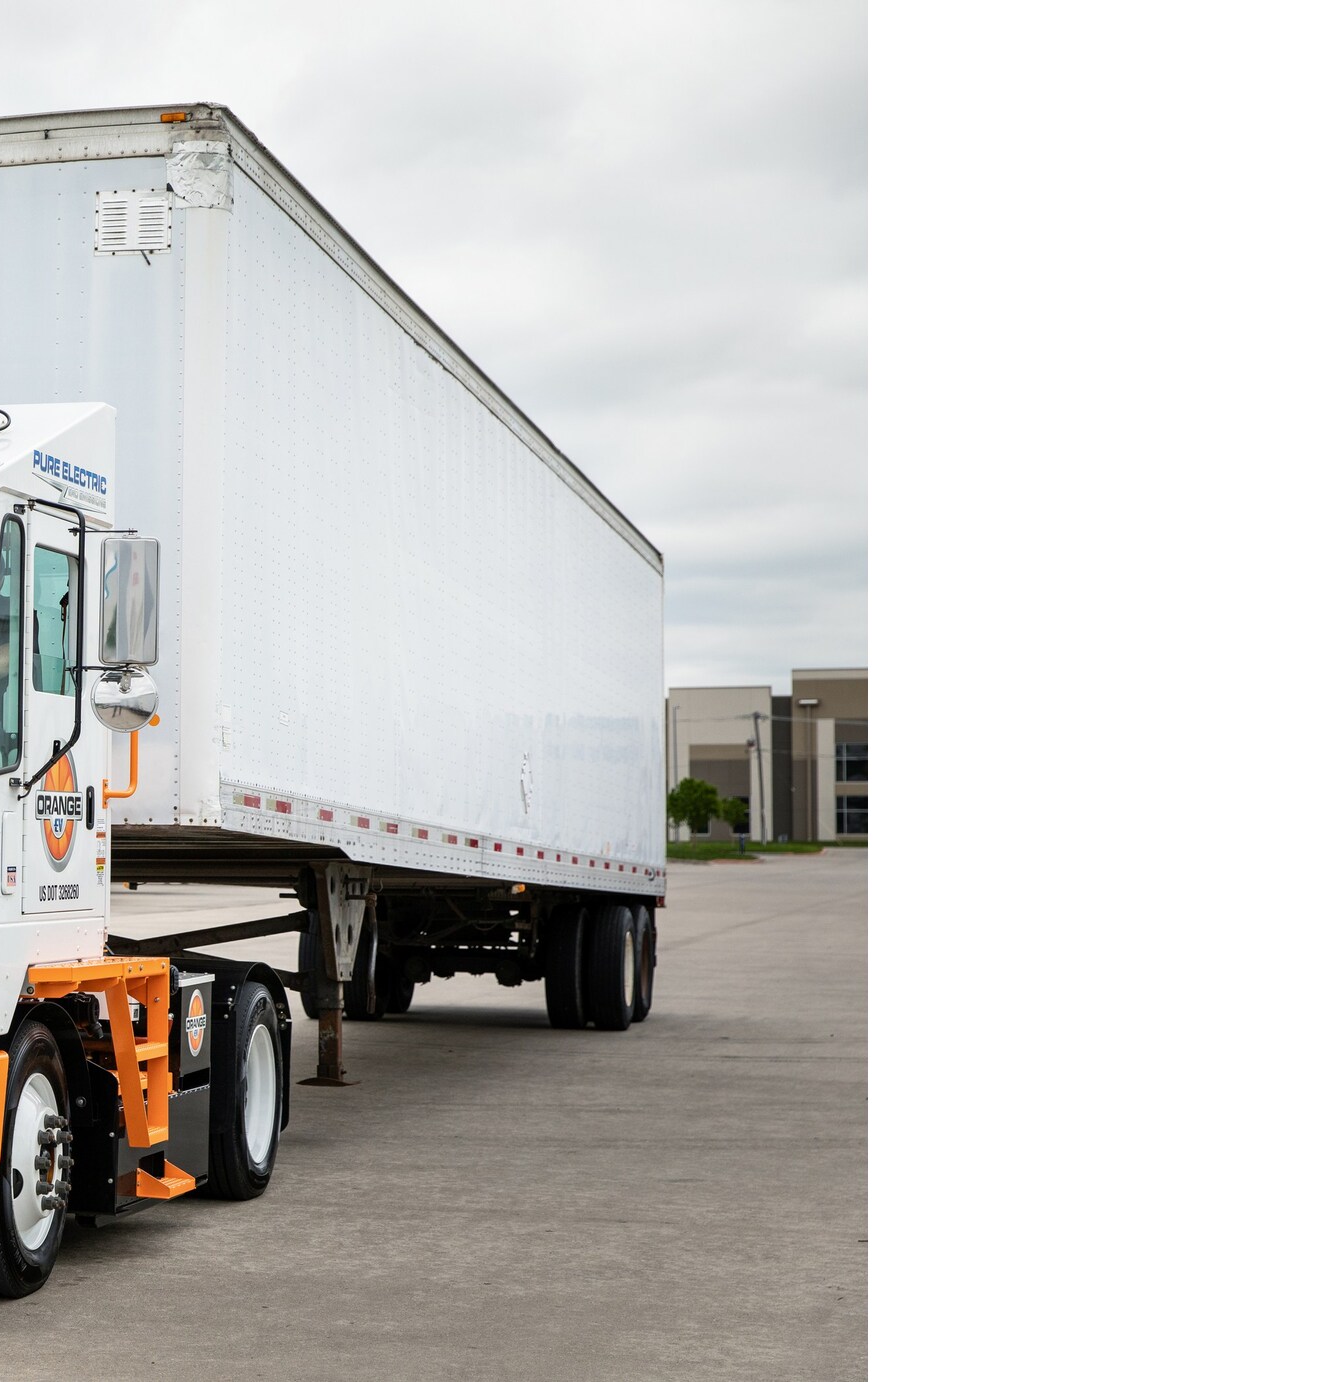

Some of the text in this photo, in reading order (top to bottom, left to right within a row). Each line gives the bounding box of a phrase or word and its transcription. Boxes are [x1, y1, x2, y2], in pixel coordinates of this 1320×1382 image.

[33, 449, 107, 495] PURE ELECTRIC
[37, 795, 82, 816] ORANGE
[53, 818, 63, 832] EV
[39, 885, 46, 901] US
[47, 885, 57, 900] DOT
